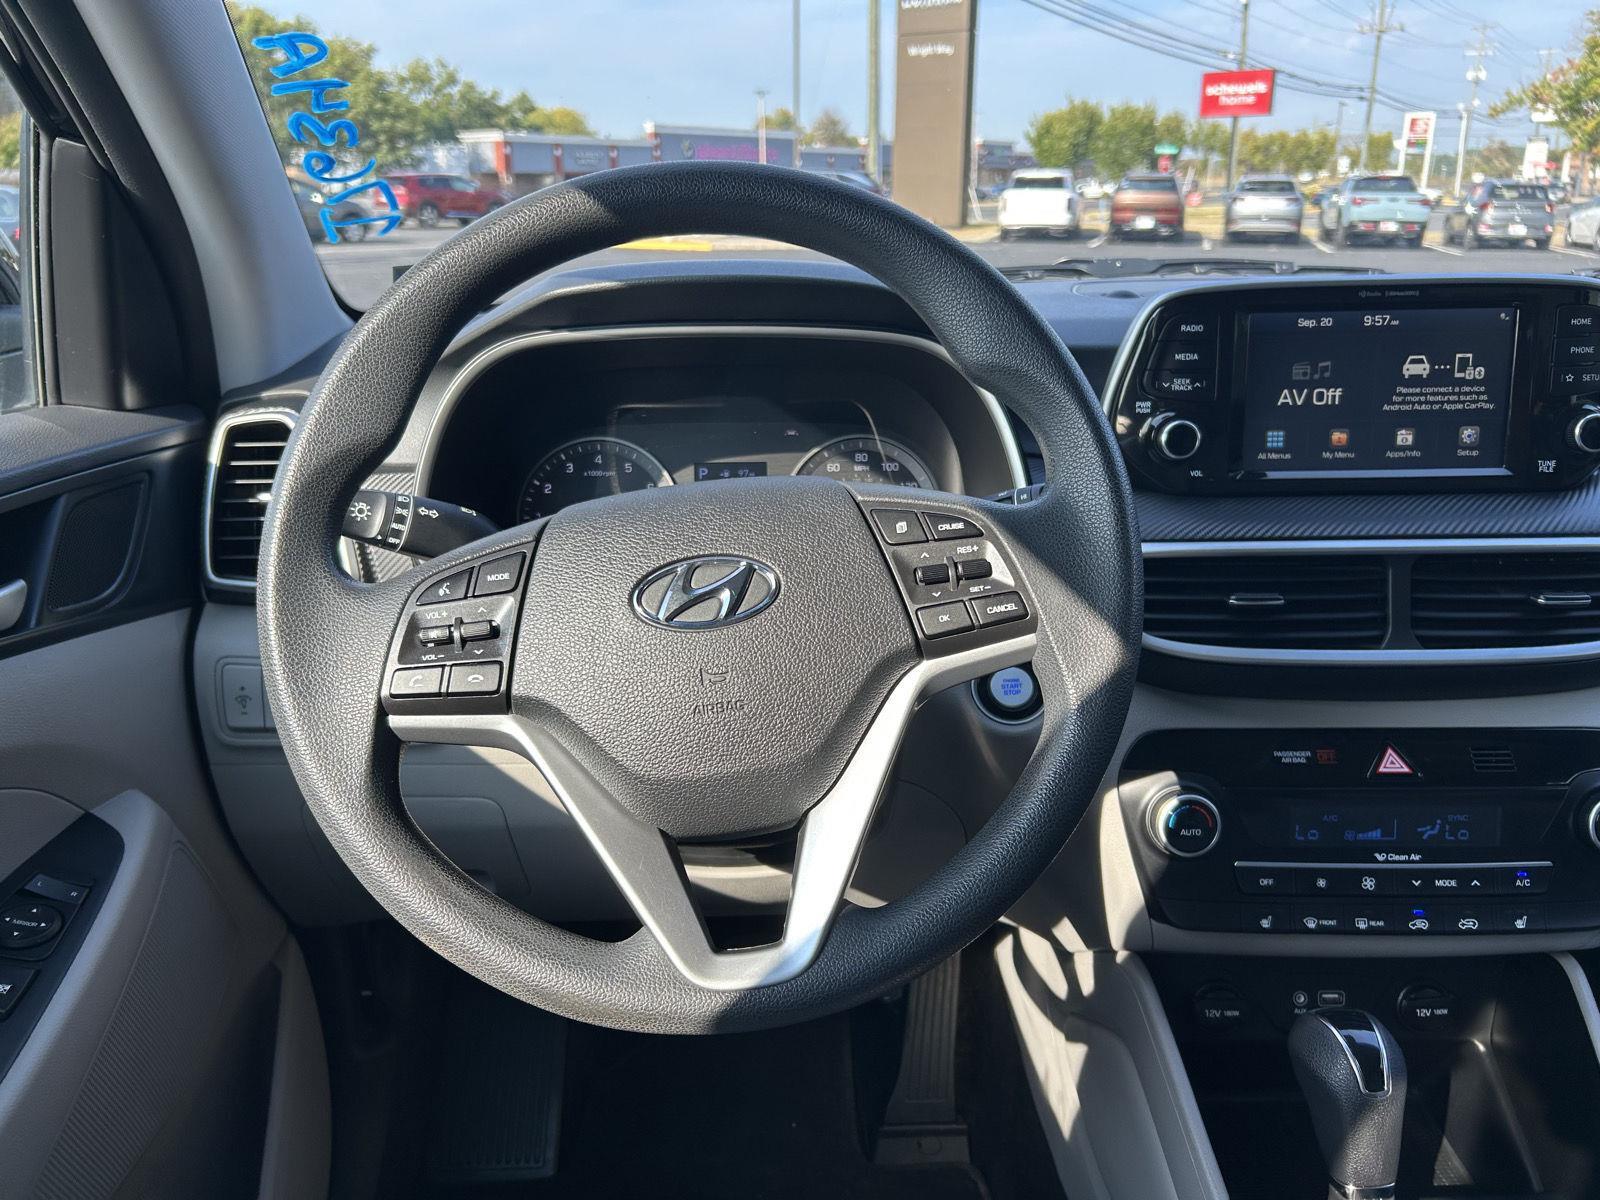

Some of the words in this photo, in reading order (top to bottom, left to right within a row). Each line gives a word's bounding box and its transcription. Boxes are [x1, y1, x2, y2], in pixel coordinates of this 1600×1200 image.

[1297, 318, 1318, 328] Sep.
[1320, 317, 1333, 327] 20
[1363, 315, 1390, 326] 9:57
[1570, 318, 1592, 326] HOME
[1180, 324, 1204, 332] RADIO
[1570, 346, 1595, 354] PHONE
[1174, 353, 1198, 361] MEDIA
[1396, 386, 1421, 394] Please
[1277, 388, 1308, 406] AV
[1312, 388, 1343, 406] Off
[1442, 402, 1463, 412] Apple
[1464, 402, 1496, 411] CarPlay.
[854, 453, 868, 462] 80
[1322, 452, 1333, 460] My
[1385, 450, 1421, 458] Apps/Info
[594, 455, 602, 464] 4
[566, 463, 574, 474] 3
[624, 463, 632, 473] 5
[826, 463, 840, 472] 60
[881, 463, 899, 472] 100
[699, 467, 708, 480] P
[544, 483, 552, 494] 2
[391, 522, 406, 532] AUTO
[938, 522, 964, 531] CRUISE
[388, 536, 401, 544] OFF
[957, 545, 979, 554] RES+
[487, 572, 510, 582] MODE
[986, 602, 1018, 614] CANCEL
[425, 610, 448, 620] VOL+
[938, 614, 950, 622] OK
[691, 699, 746, 718] AIRBAG
[1448, 814, 1470, 822] SYNC
[1180, 828, 1202, 836] AUTO
[1387, 853, 1409, 862] Clean
[1410, 853, 1422, 861] Air
[1260, 878, 1274, 886] OFF
[12, 919, 38, 927] MIRROR
[1205, 1009, 1221, 1018] 12V
[1416, 1008, 1432, 1017] 12V
